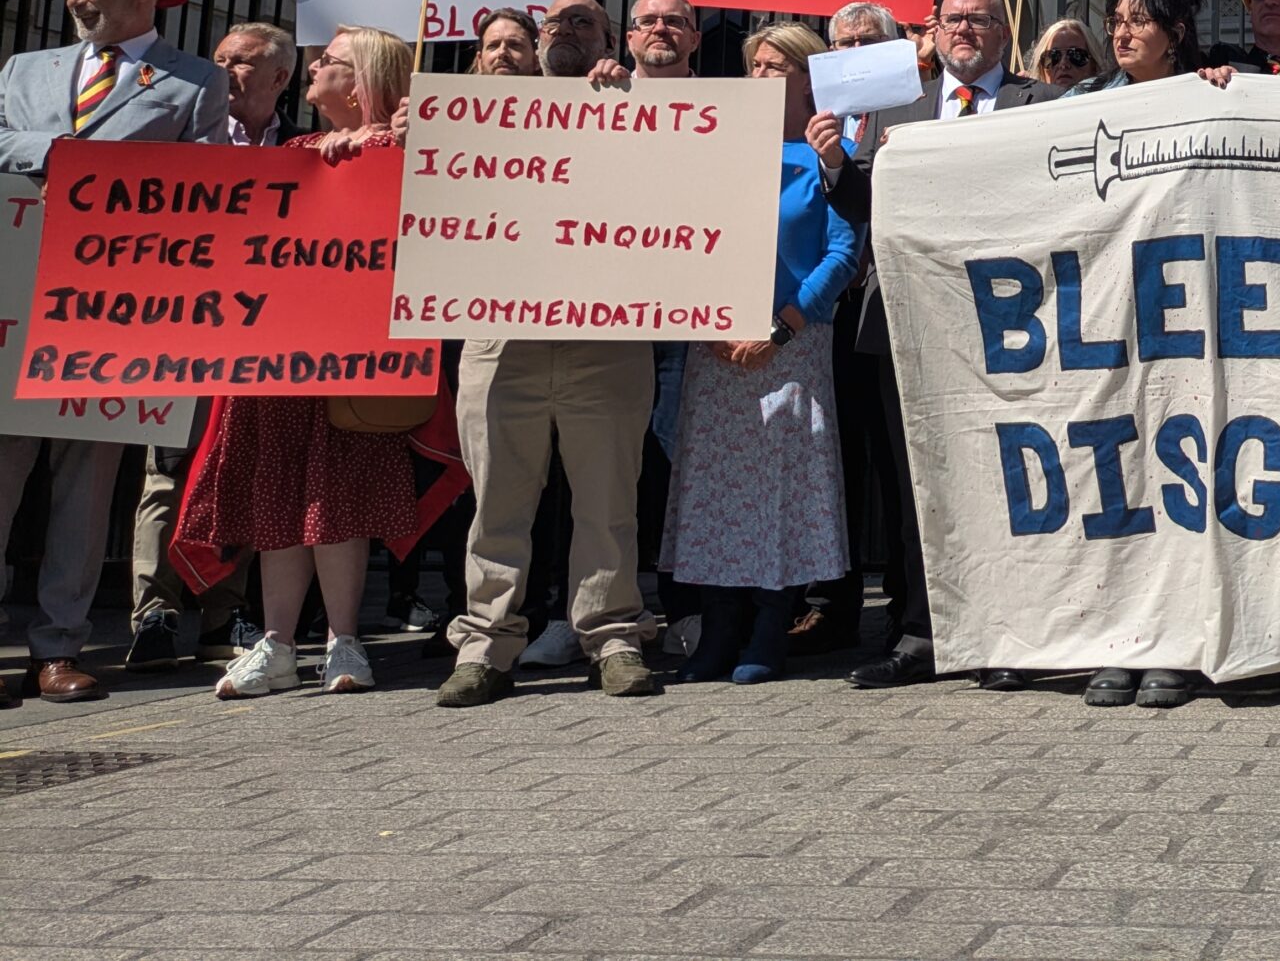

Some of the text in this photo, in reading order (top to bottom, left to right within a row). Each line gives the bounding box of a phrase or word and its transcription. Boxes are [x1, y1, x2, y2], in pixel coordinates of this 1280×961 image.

[418, 95, 718, 134] GOVERNMENTS
[414, 148, 572, 184] IGNORE
[68, 173, 299, 219] CABINET
[74, 233, 216, 269] OFFICE
[554, 219, 722, 254] INQUIRY
[44, 287, 268, 327] INQUIRY
[26, 344, 434, 384] RECOMMENDATION
[59, 398, 174, 425] NOW
